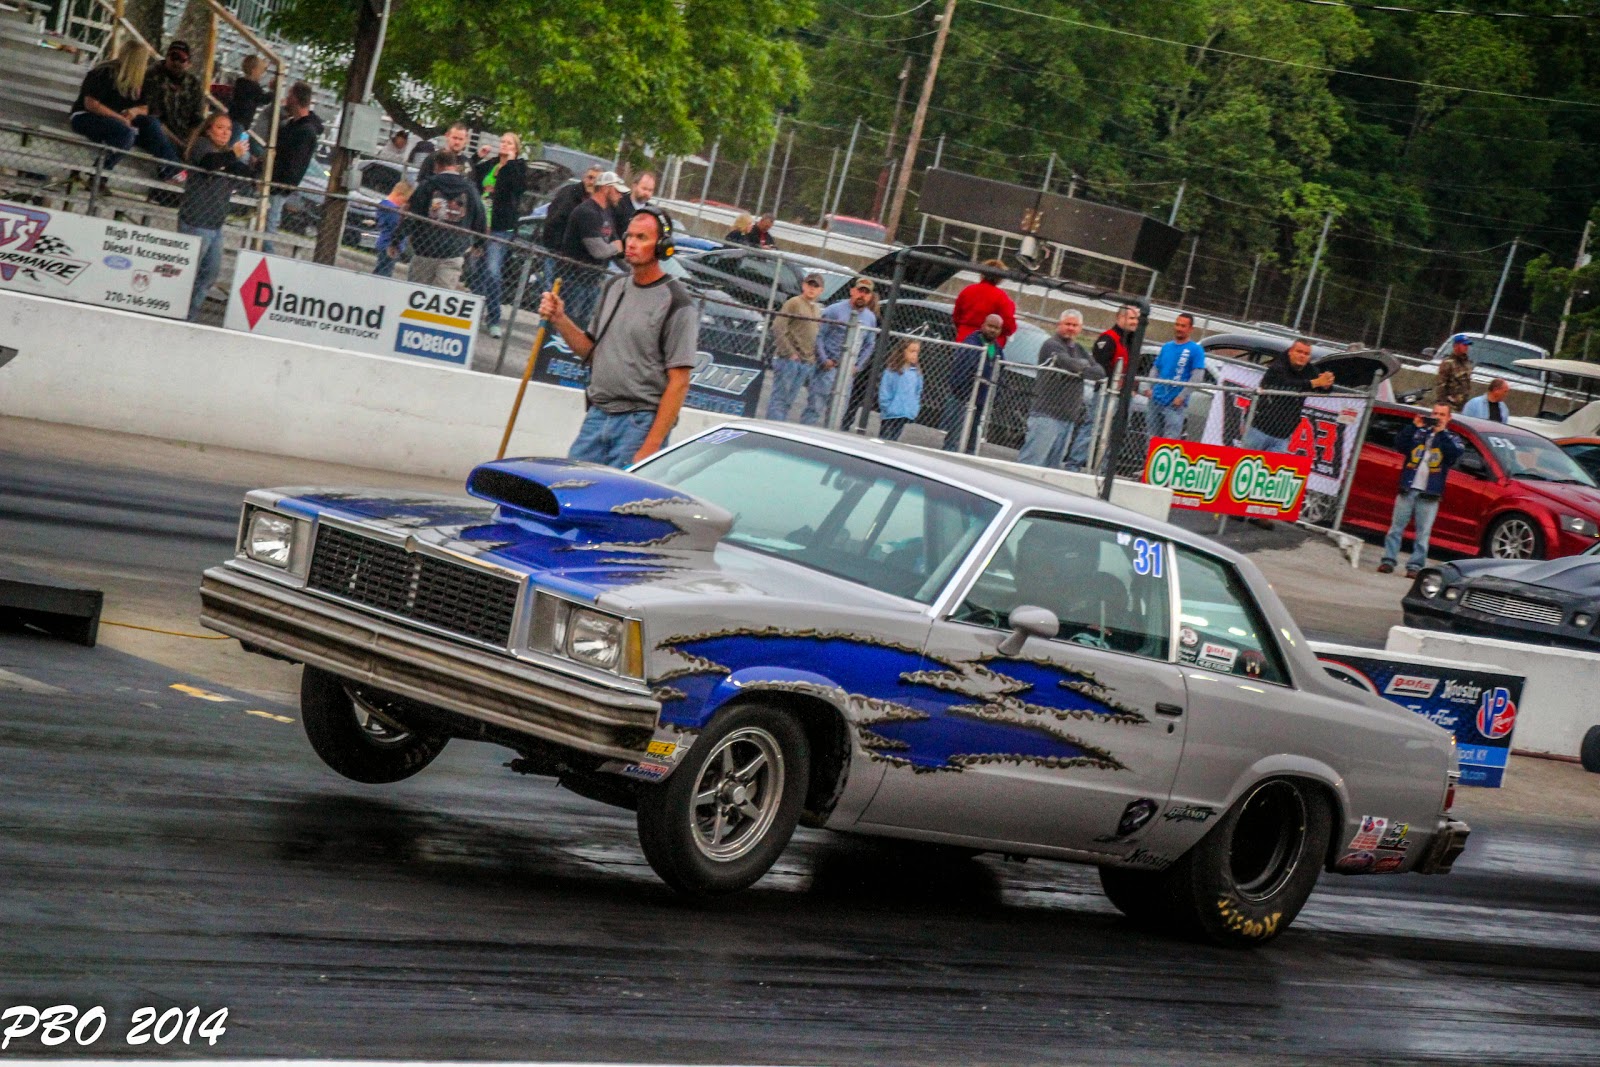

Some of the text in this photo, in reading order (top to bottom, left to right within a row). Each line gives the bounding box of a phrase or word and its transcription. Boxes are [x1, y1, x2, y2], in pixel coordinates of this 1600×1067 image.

[102, 240, 133, 256] Diesel
[134, 247, 190, 265] Accessories
[105, 226, 190, 251] High Performance
[254, 281, 385, 329] Diamond
[409, 290, 476, 319] CASE
[269, 313, 380, 340] EQUIPMENT OF KENTUCKY
[401, 329, 463, 357] KOBELCO
[1151, 450, 1225, 497] O'Reilly
[1234, 461, 1303, 507] O'Reilly
[1132, 537, 1162, 578] 31
[1482, 686, 1511, 736] VP
